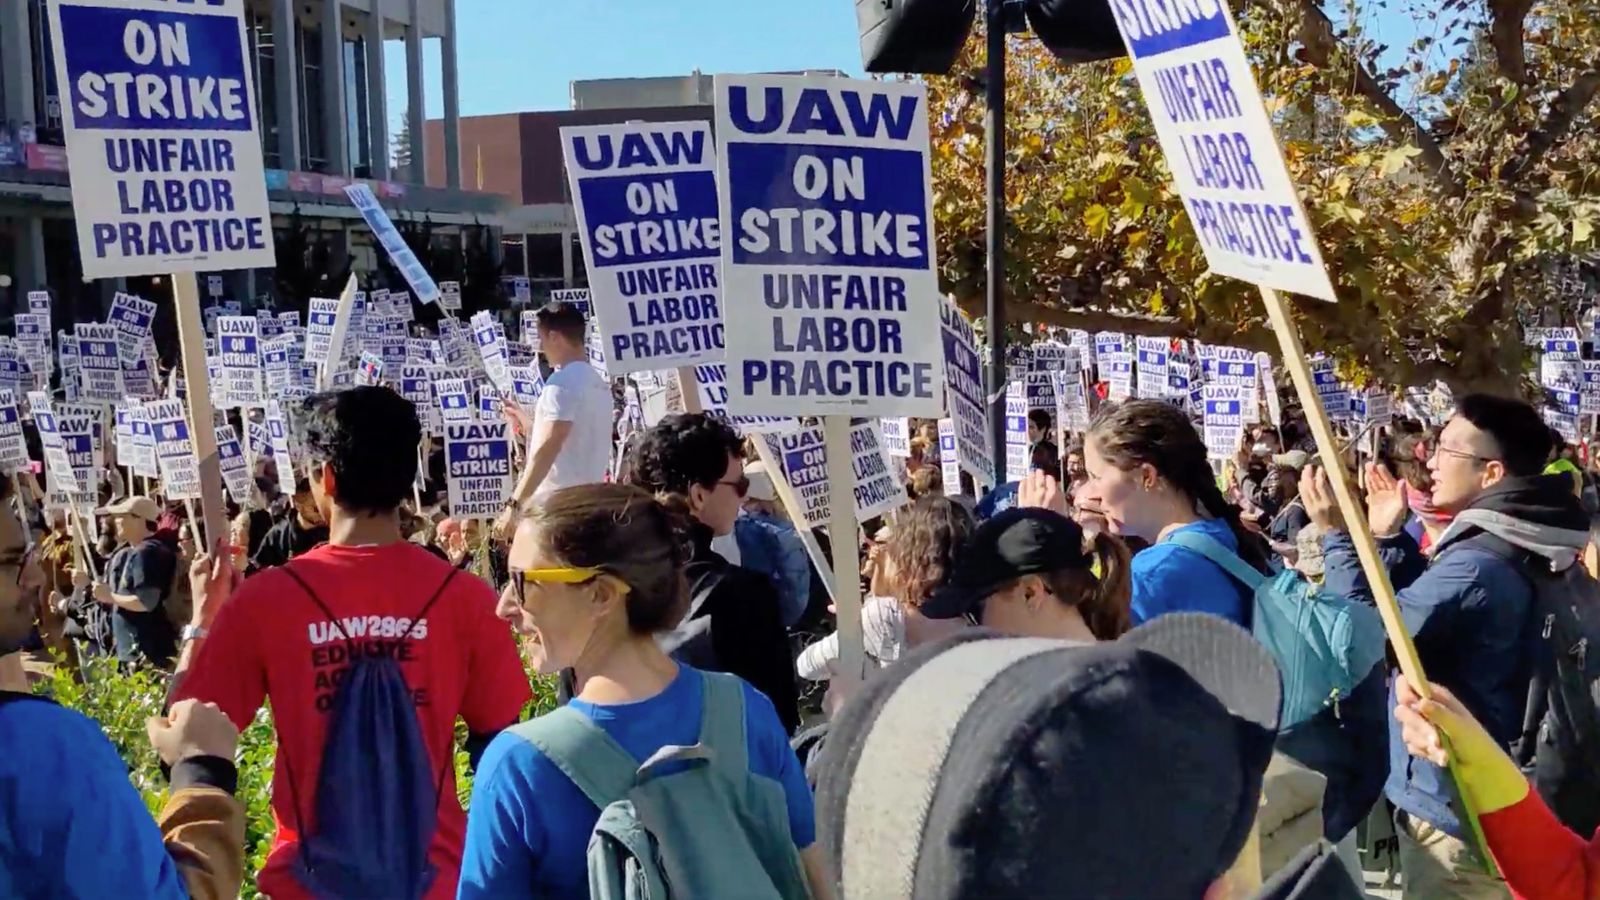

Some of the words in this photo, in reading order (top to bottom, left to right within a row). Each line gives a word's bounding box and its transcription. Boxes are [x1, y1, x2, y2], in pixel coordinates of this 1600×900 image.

[122, 19, 190, 67] ON
[77, 71, 245, 120] STRIKE
[1153, 58, 1242, 123] UNFAIR
[728, 85, 919, 141] UAW
[104, 138, 236, 173] UNFAIR
[572, 131, 705, 170] UAW
[1180, 132, 1264, 191] LABOR
[792, 154, 865, 201] ON
[117, 178, 235, 214] LABOR
[626, 179, 679, 215] ON
[93, 217, 266, 258] PRACTICE
[594, 217, 721, 258] STRIKE
[738, 207, 923, 258] STRIKE
[1189, 198, 1314, 264] PRACTICE
[616, 264, 717, 296] UNFAIR
[553, 291, 587, 300] UAW
[763, 273, 907, 311] UNFAIR
[115, 295, 153, 314] UAW
[312, 301, 338, 312] UAW
[628, 294, 719, 327] LABOR
[123, 310, 139, 322] ON
[78, 327, 115, 339] UAW
[220, 320, 254, 333] UAW
[612, 323, 725, 361] PRACTIC
[772, 316, 903, 353] LABOR
[90, 343, 106, 355] ON
[231, 338, 246, 352] ON
[1138, 339, 1166, 351] UAW
[1200, 348, 1215, 357] UA
[82, 355, 118, 369] STRIKE
[224, 353, 258, 367] STRIKE
[1219, 350, 1254, 360] UAW
[403, 368, 427, 378] UA
[430, 368, 470, 380] UAW
[1583, 362, 1600, 371] UA
[742, 359, 933, 398] PRACTICE
[1028, 374, 1053, 384] UA
[1205, 387, 1240, 398] UAW
[148, 404, 181, 420] UAW
[1008, 402, 1026, 414] AW
[1215, 401, 1230, 413] ON
[59, 418, 90, 432] AW
[448, 424, 508, 440] UAW
[883, 422, 899, 435] BOR
[216, 427, 234, 441] AW
[850, 427, 879, 454] NFAIR
[467, 443, 490, 458] ON
[803, 447, 825, 465] ON
[451, 460, 508, 475] STRIKE
[852, 452, 887, 481] LABOR
[792, 465, 828, 485] STRI
[459, 479, 503, 490] UNFAIR
[801, 483, 830, 498] UNFA
[462, 490, 500, 502] LABOR
[807, 496, 830, 510] LAB
[454, 502, 507, 515] PRACTIC
[308, 615, 428, 644] UAW2865
